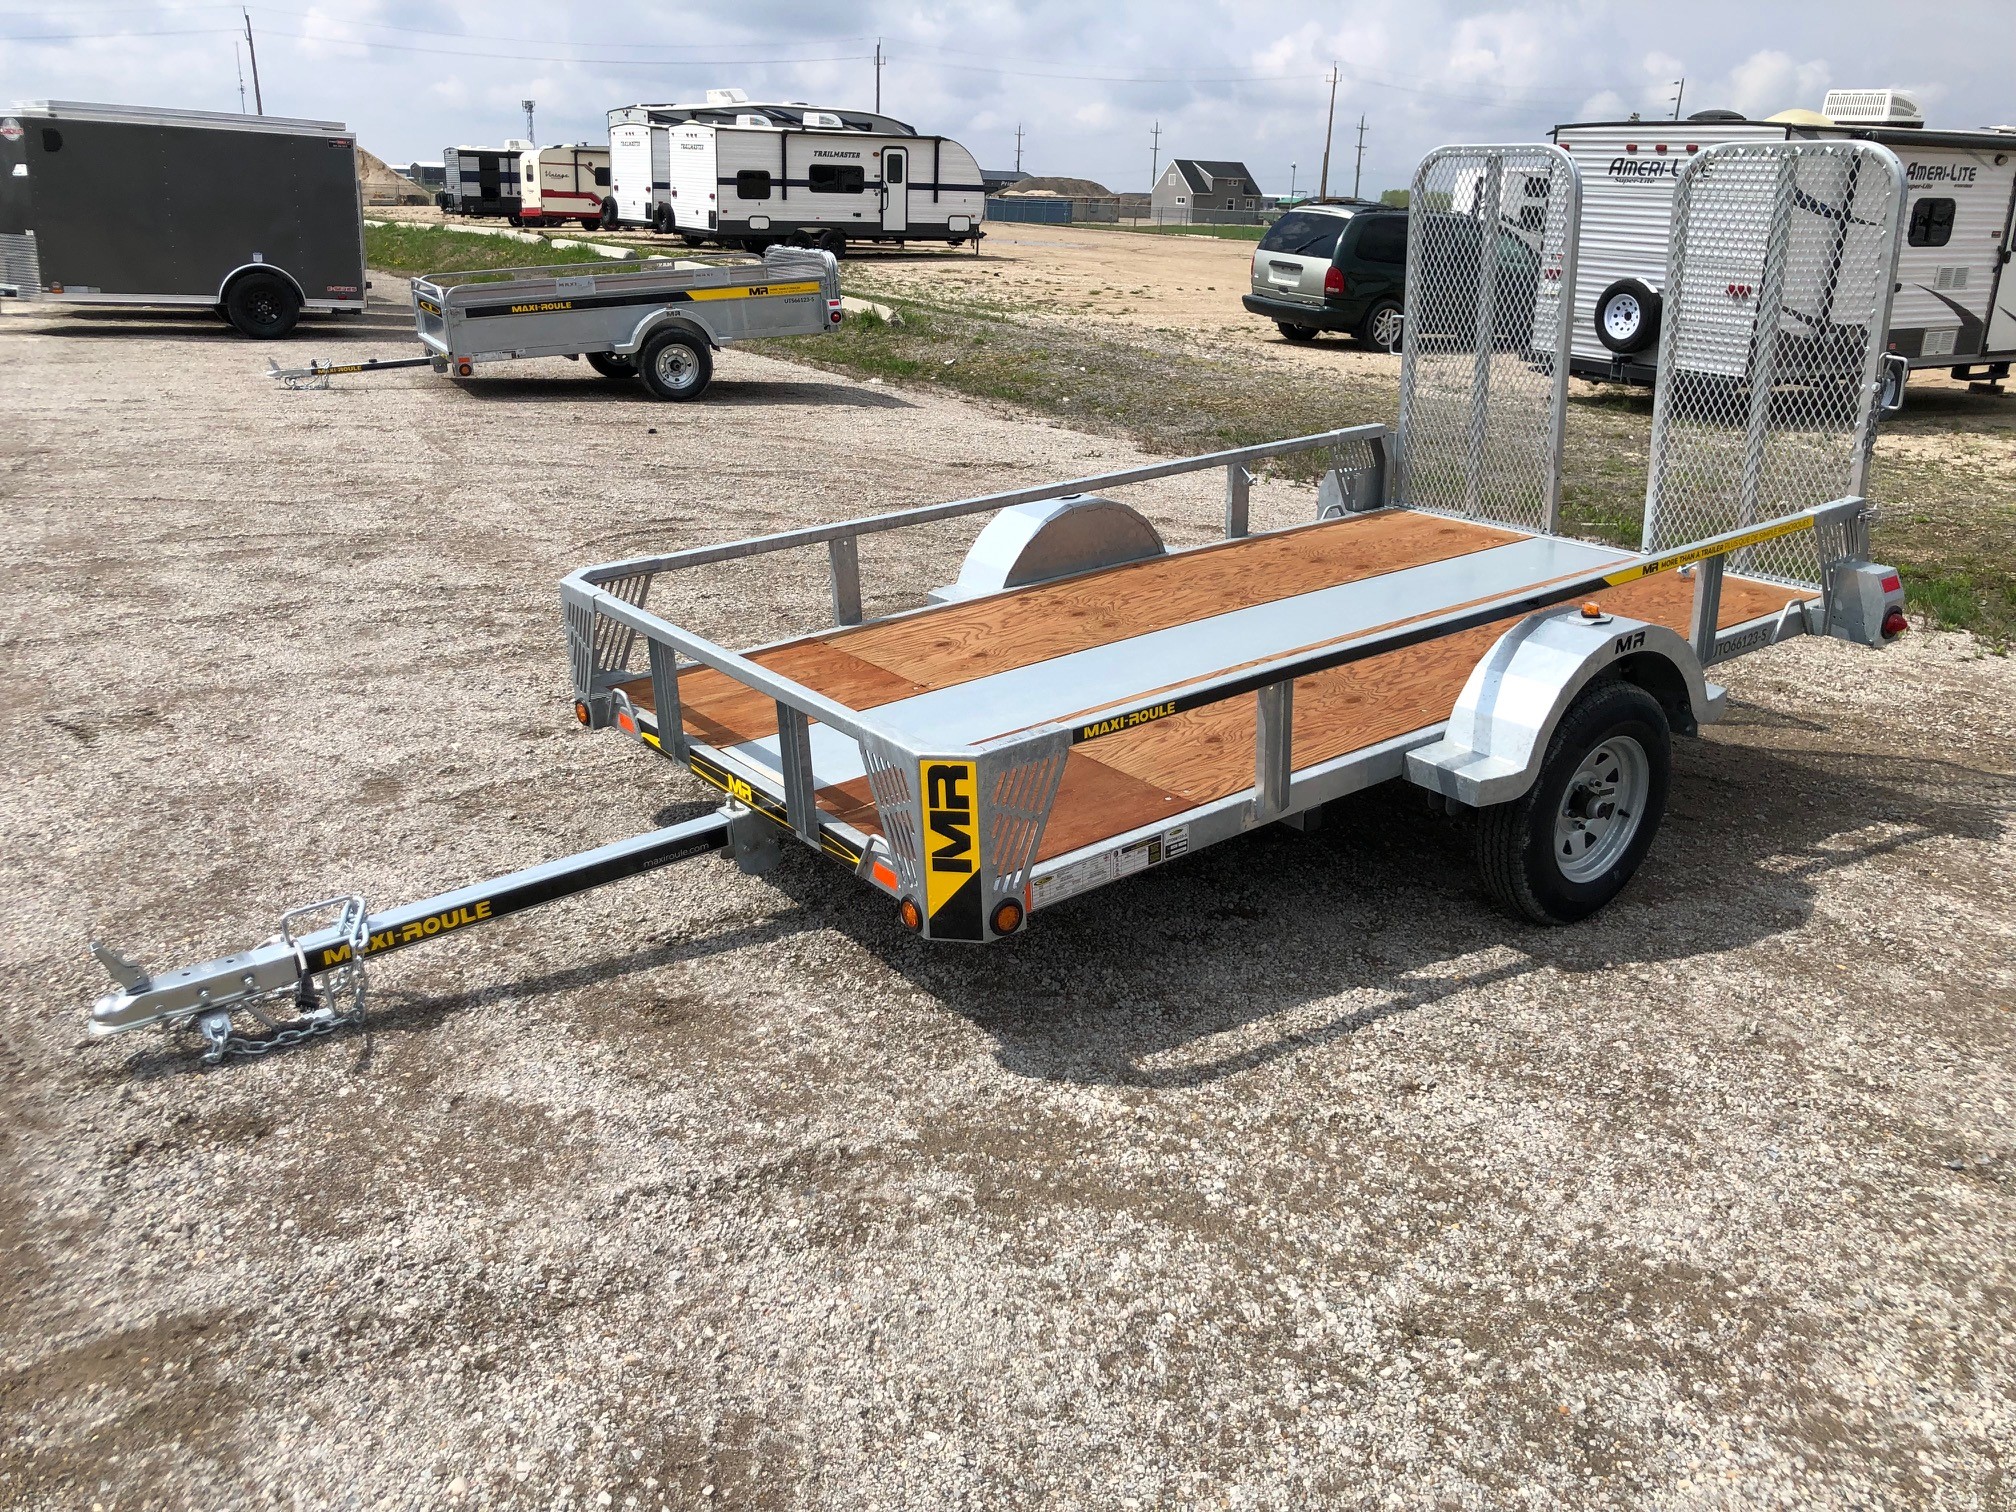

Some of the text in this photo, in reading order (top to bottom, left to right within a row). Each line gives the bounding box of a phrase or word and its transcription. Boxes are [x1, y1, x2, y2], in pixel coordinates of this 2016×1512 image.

[813, 150, 861, 158] TRAILMASTER
[1906, 162, 1977, 182] AMERI-LITE
[1907, 183, 1934, 191] uper-Lite
[749, 287, 769, 296] MR
[511, 301, 572, 313] MAXI-ROULE
[1642, 562, 1659, 576] MR
[1661, 557, 1678, 568] MORE
[1679, 552, 1695, 565] THAN
[1700, 543, 1724, 558] TRAILER
[1724, 538, 1740, 550] PLUS
[1739, 536, 1750, 547] QUE
[1750, 534, 1759, 544] DE
[1759, 528, 1778, 541] SIMPLE
[1615, 631, 1646, 655] MR
[1083, 702, 1176, 739] MAXI-ROULE
[728, 773, 752, 802] MR
[927, 764, 973, 873] MR
[643, 843, 710, 868] maxiroule.com
[323, 901, 492, 966] MXI-ROULE
